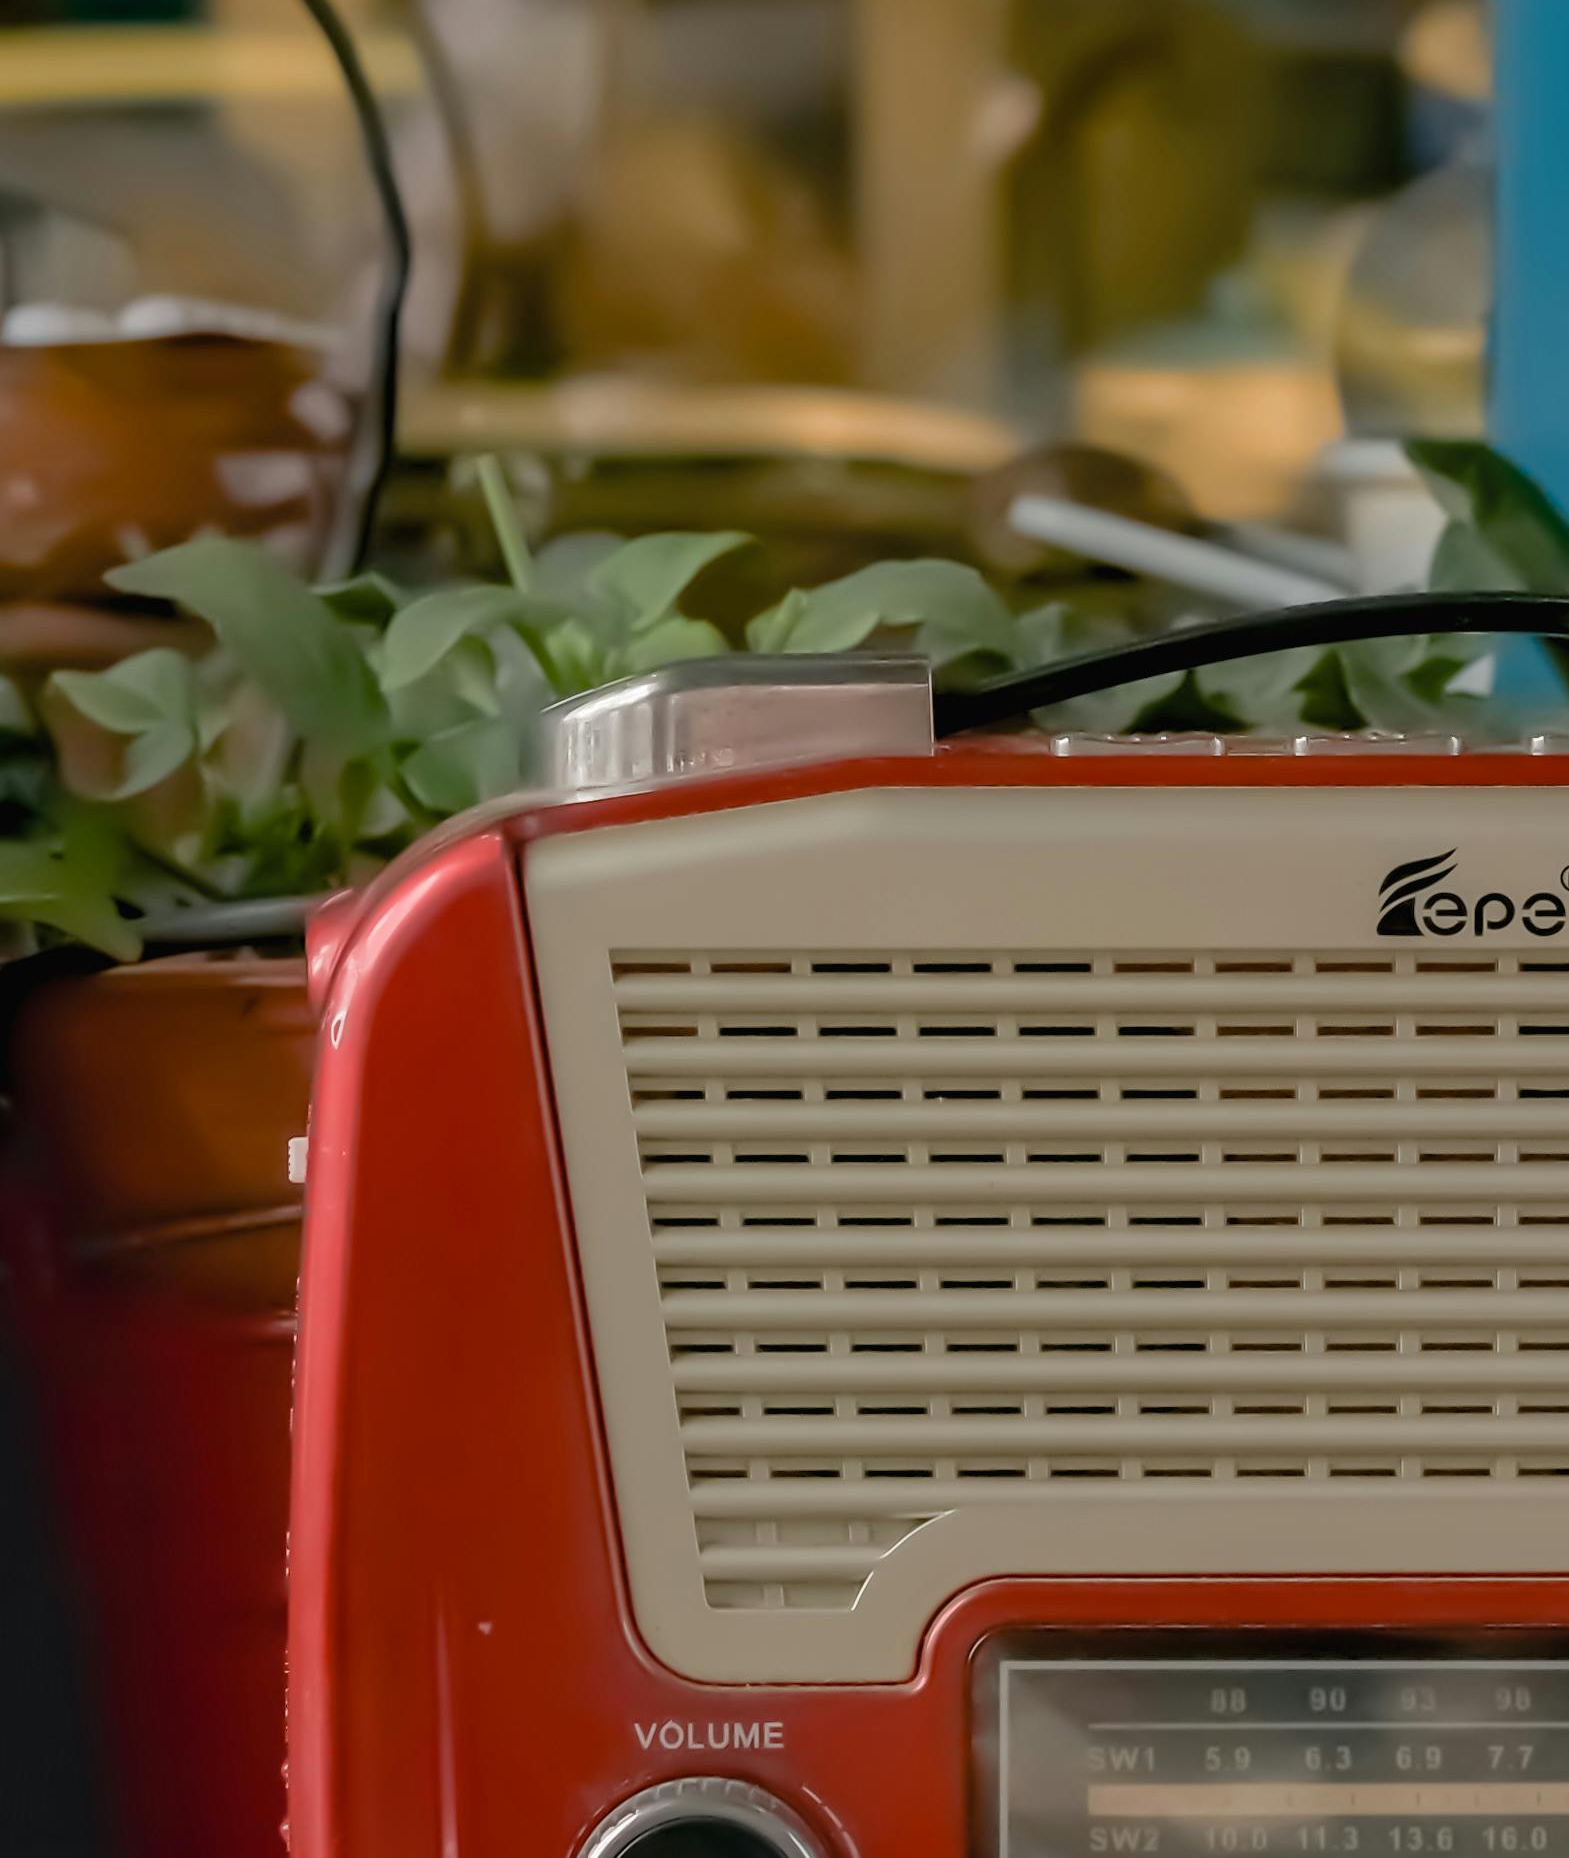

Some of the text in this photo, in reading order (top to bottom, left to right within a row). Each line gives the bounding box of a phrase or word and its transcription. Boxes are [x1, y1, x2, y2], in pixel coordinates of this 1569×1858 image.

[1210, 1688, 1247, 1713] 88
[1309, 1687, 1347, 1712] 90
[1496, 1686, 1532, 1712] 98
[634, 1721, 785, 1749] VOLUME
[1087, 1747, 1156, 1771] SW1
[1205, 1746, 1251, 1771] 5.9
[1304, 1746, 1352, 1770] 6.3
[1395, 1746, 1443, 1771] 6.9
[1488, 1745, 1534, 1770] 7.7
[1089, 1828, 1160, 1852] SW2
[1204, 1827, 1268, 1851] 10.0
[1298, 1826, 1360, 1850] 11.3
[1388, 1826, 1453, 1851] 13.6
[1482, 1826, 1547, 1851] 16.0
